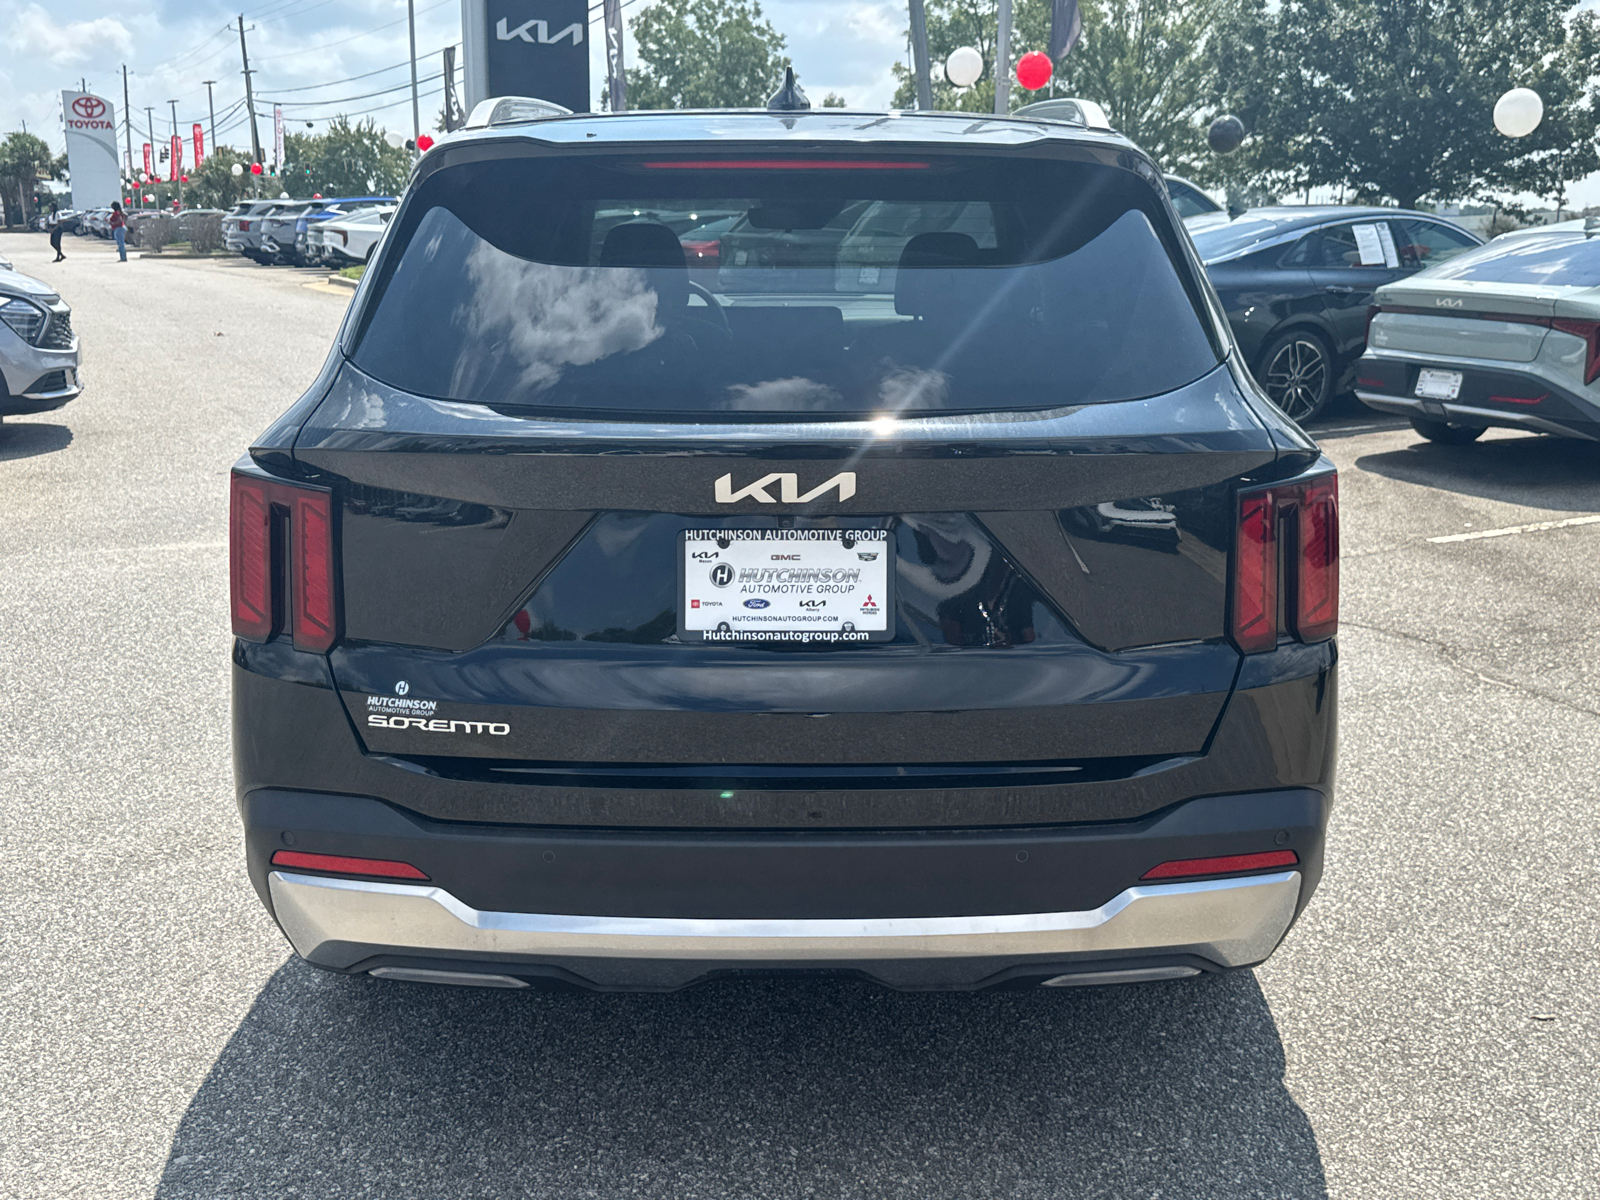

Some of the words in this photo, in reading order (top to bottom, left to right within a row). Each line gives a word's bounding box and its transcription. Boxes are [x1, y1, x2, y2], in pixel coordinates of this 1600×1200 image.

[496, 17, 583, 46] KIA
[68, 120, 113, 129] TOYOTA
[1436, 298, 1462, 307] KIA
[715, 472, 856, 503] KIA
[685, 529, 761, 540] HUTCHINSON
[764, 529, 842, 540] AUTOMOTIVE
[845, 529, 887, 540] GROUP
[738, 568, 860, 583] HUTCHINSON
[740, 585, 813, 593] AUTOMOTIVE
[816, 585, 855, 593] GROUP
[703, 629, 869, 643] Hutchinsonautogroup.com
[367, 696, 437, 710] HUTCHINSON
[369, 705, 410, 715] AUTOMOTIVE
[411, 709, 434, 717] GROUP
[368, 715, 510, 735] SORENTO
